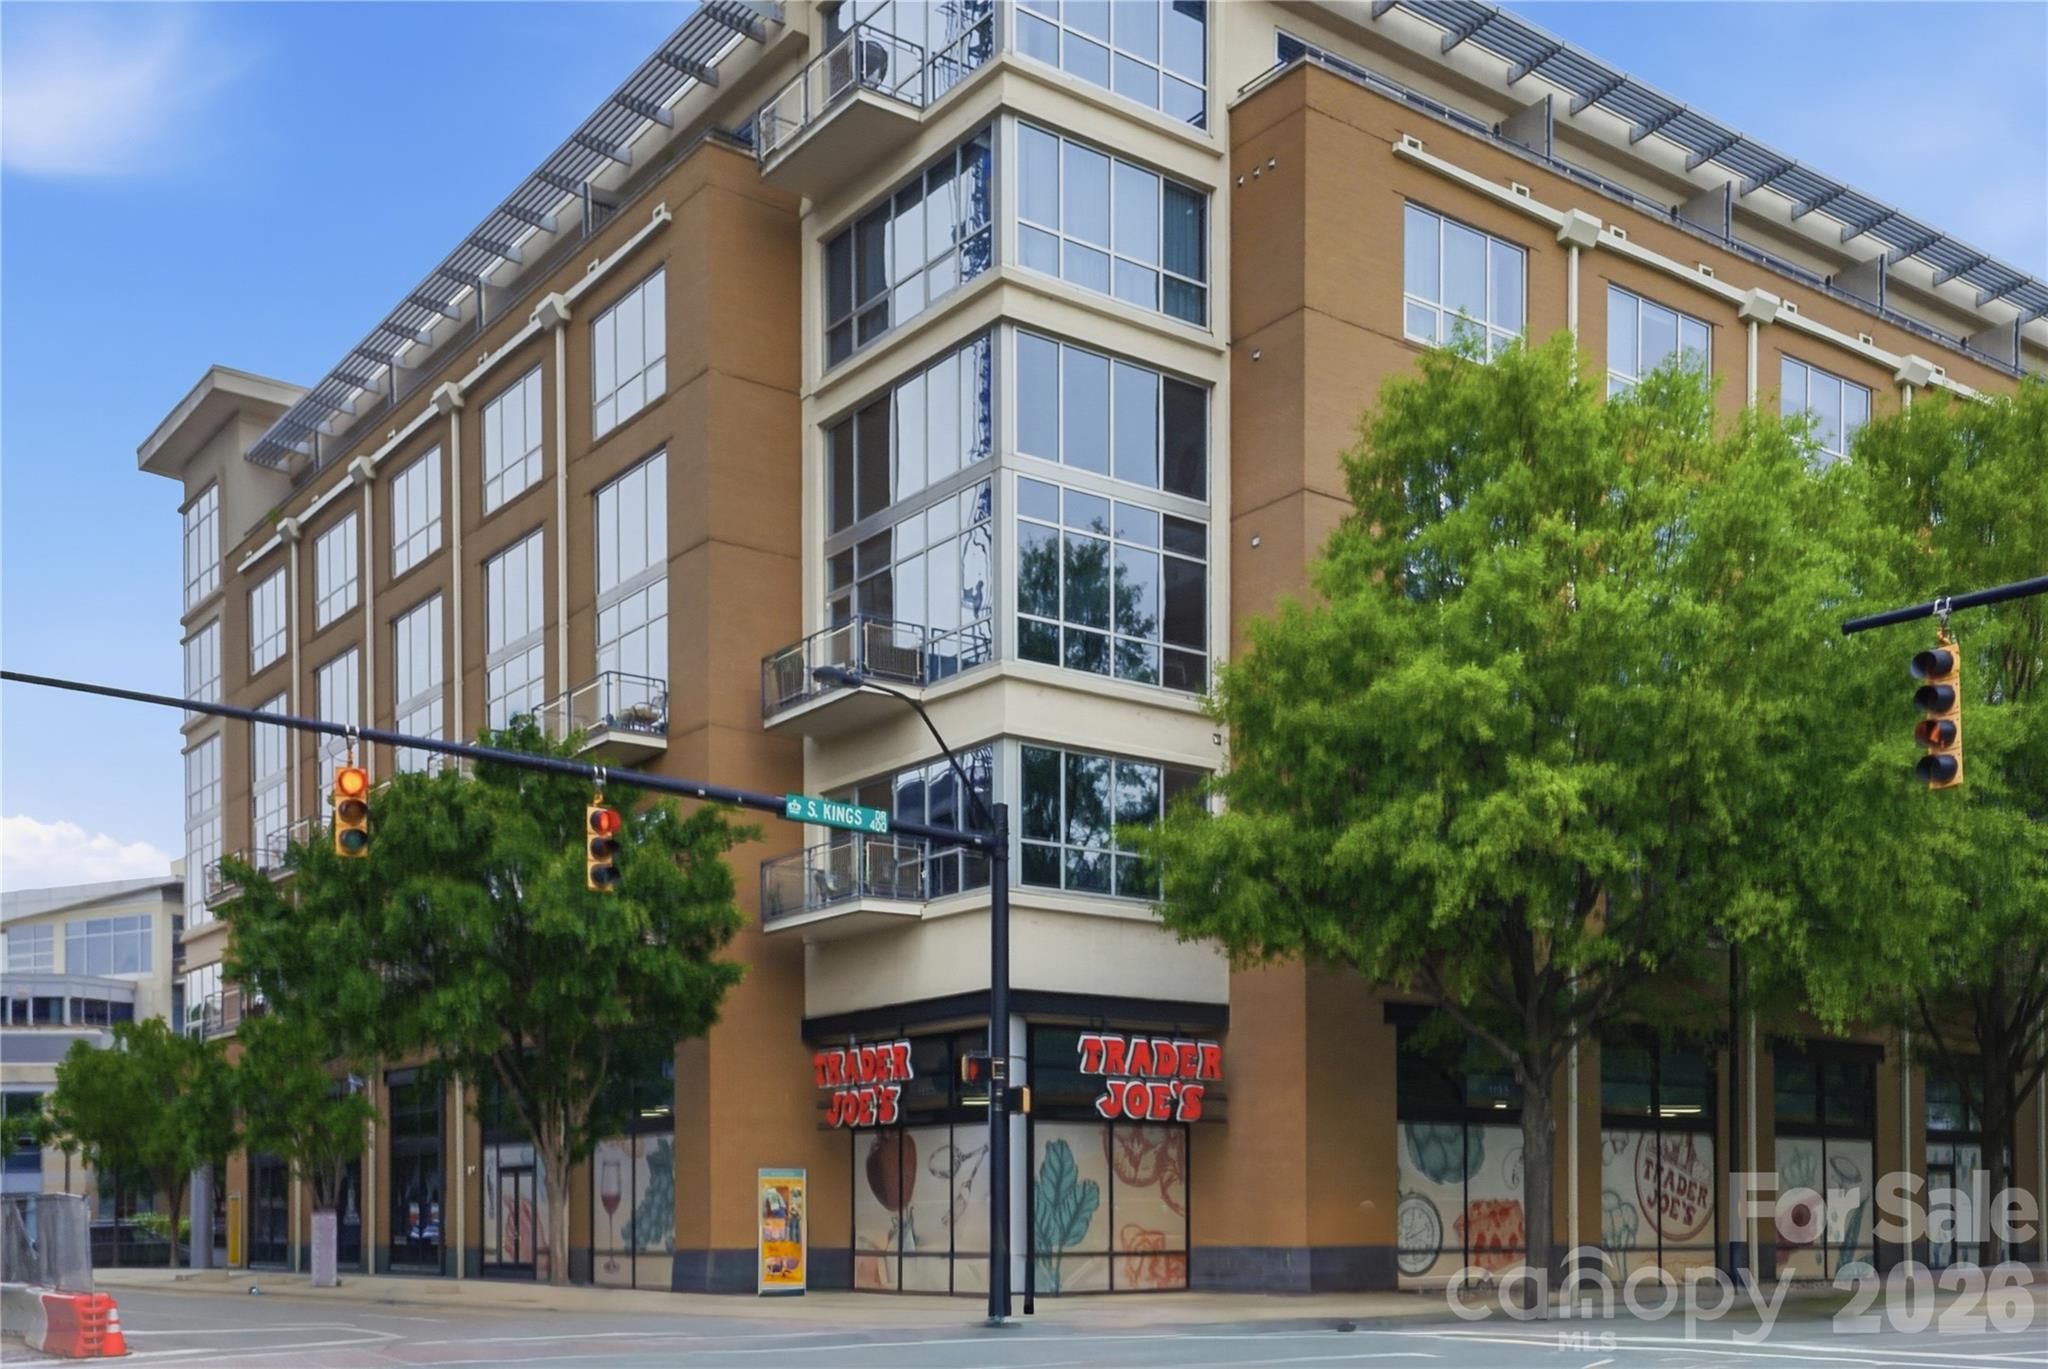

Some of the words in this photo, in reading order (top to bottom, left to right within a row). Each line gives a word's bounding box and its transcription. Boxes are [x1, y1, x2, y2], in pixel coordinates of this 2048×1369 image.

[807, 801, 818, 818] S.
[823, 804, 862, 826] KINGS
[869, 819, 887, 832] 400
[874, 810, 887, 820] DR
[814, 1042, 914, 1088] TRADER
[1077, 1034, 1223, 1080] TRADER
[826, 1085, 900, 1127] JOE'S
[1096, 1080, 1205, 1121] JOE'S
